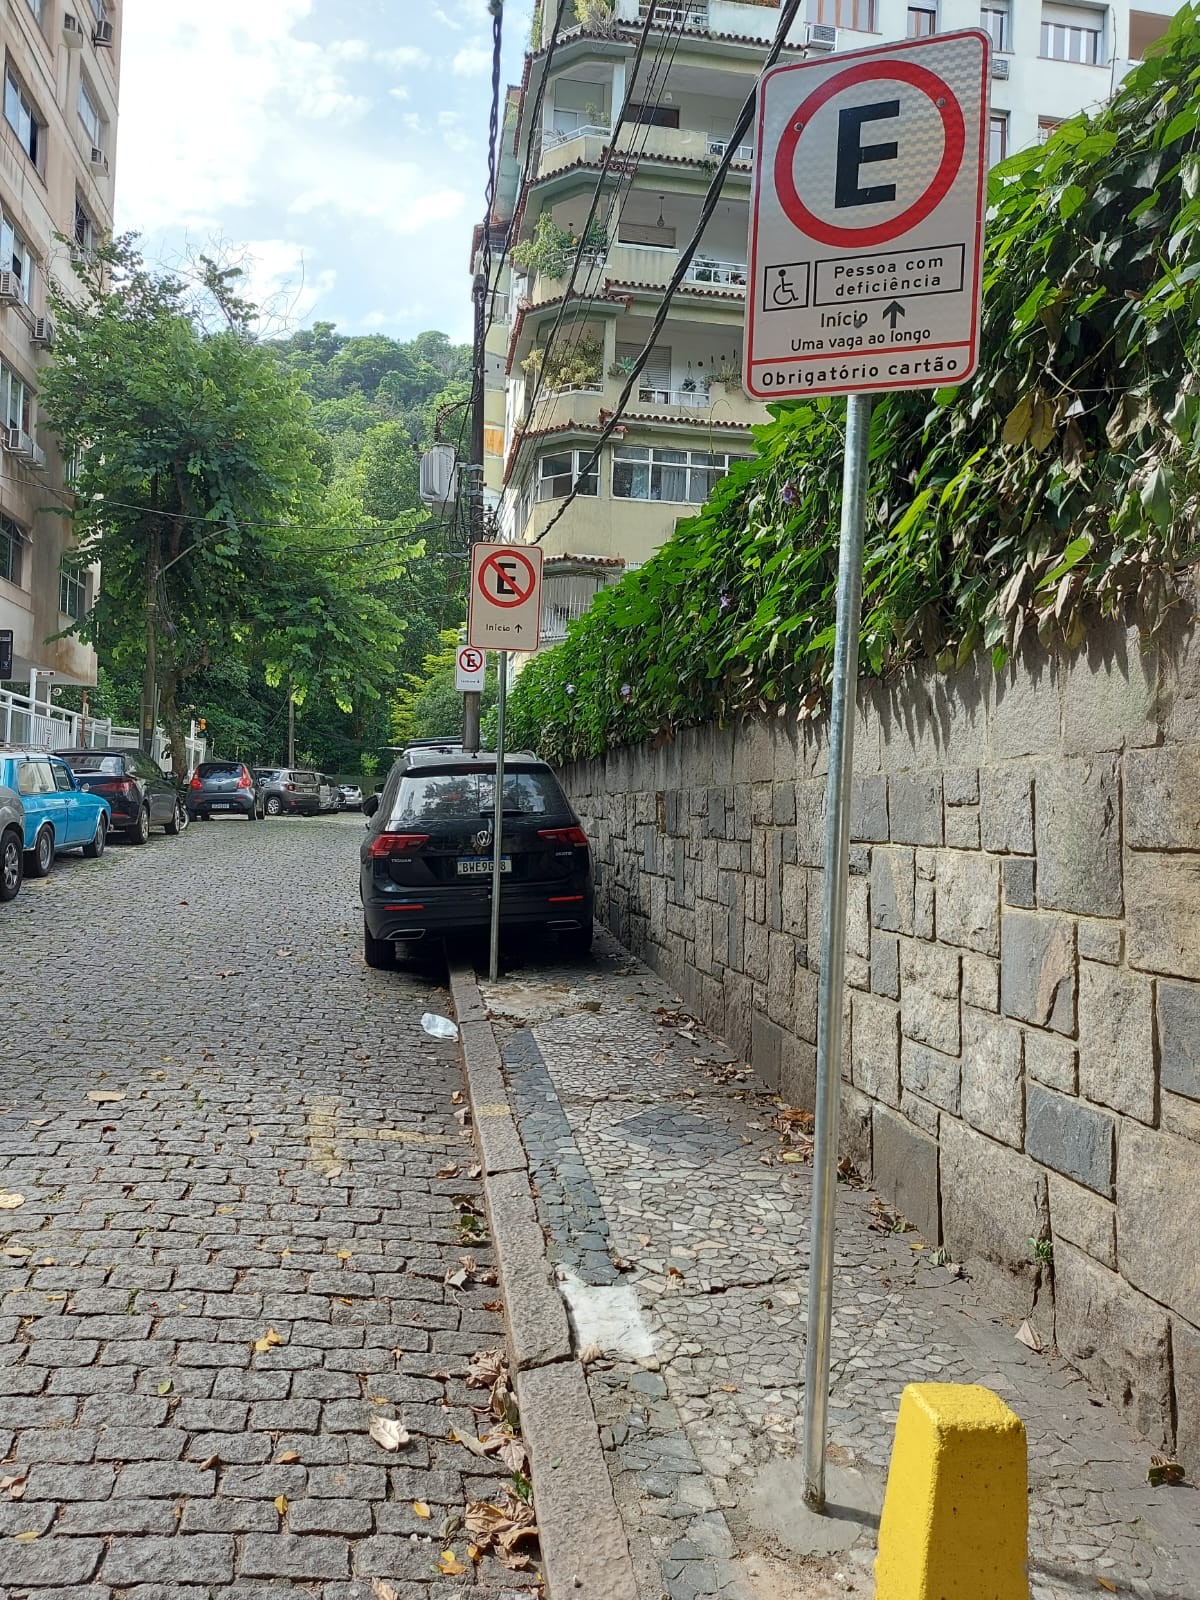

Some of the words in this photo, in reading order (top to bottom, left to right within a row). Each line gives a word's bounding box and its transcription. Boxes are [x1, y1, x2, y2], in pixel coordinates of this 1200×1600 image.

[835, 99, 900, 208] E
[834, 262, 896, 279] Pessoa
[905, 257, 943, 271] com
[835, 274, 941, 296] deficiência
[820, 310, 868, 328] Início
[791, 338, 824, 351] Uma
[828, 335, 863, 350] vaga
[868, 334, 885, 345] ao
[890, 329, 931, 344] longo
[762, 364, 879, 386] Obrigatório
[888, 356, 957, 375] cartão
[497, 563, 516, 594] E
[486, 623, 511, 632] Início
